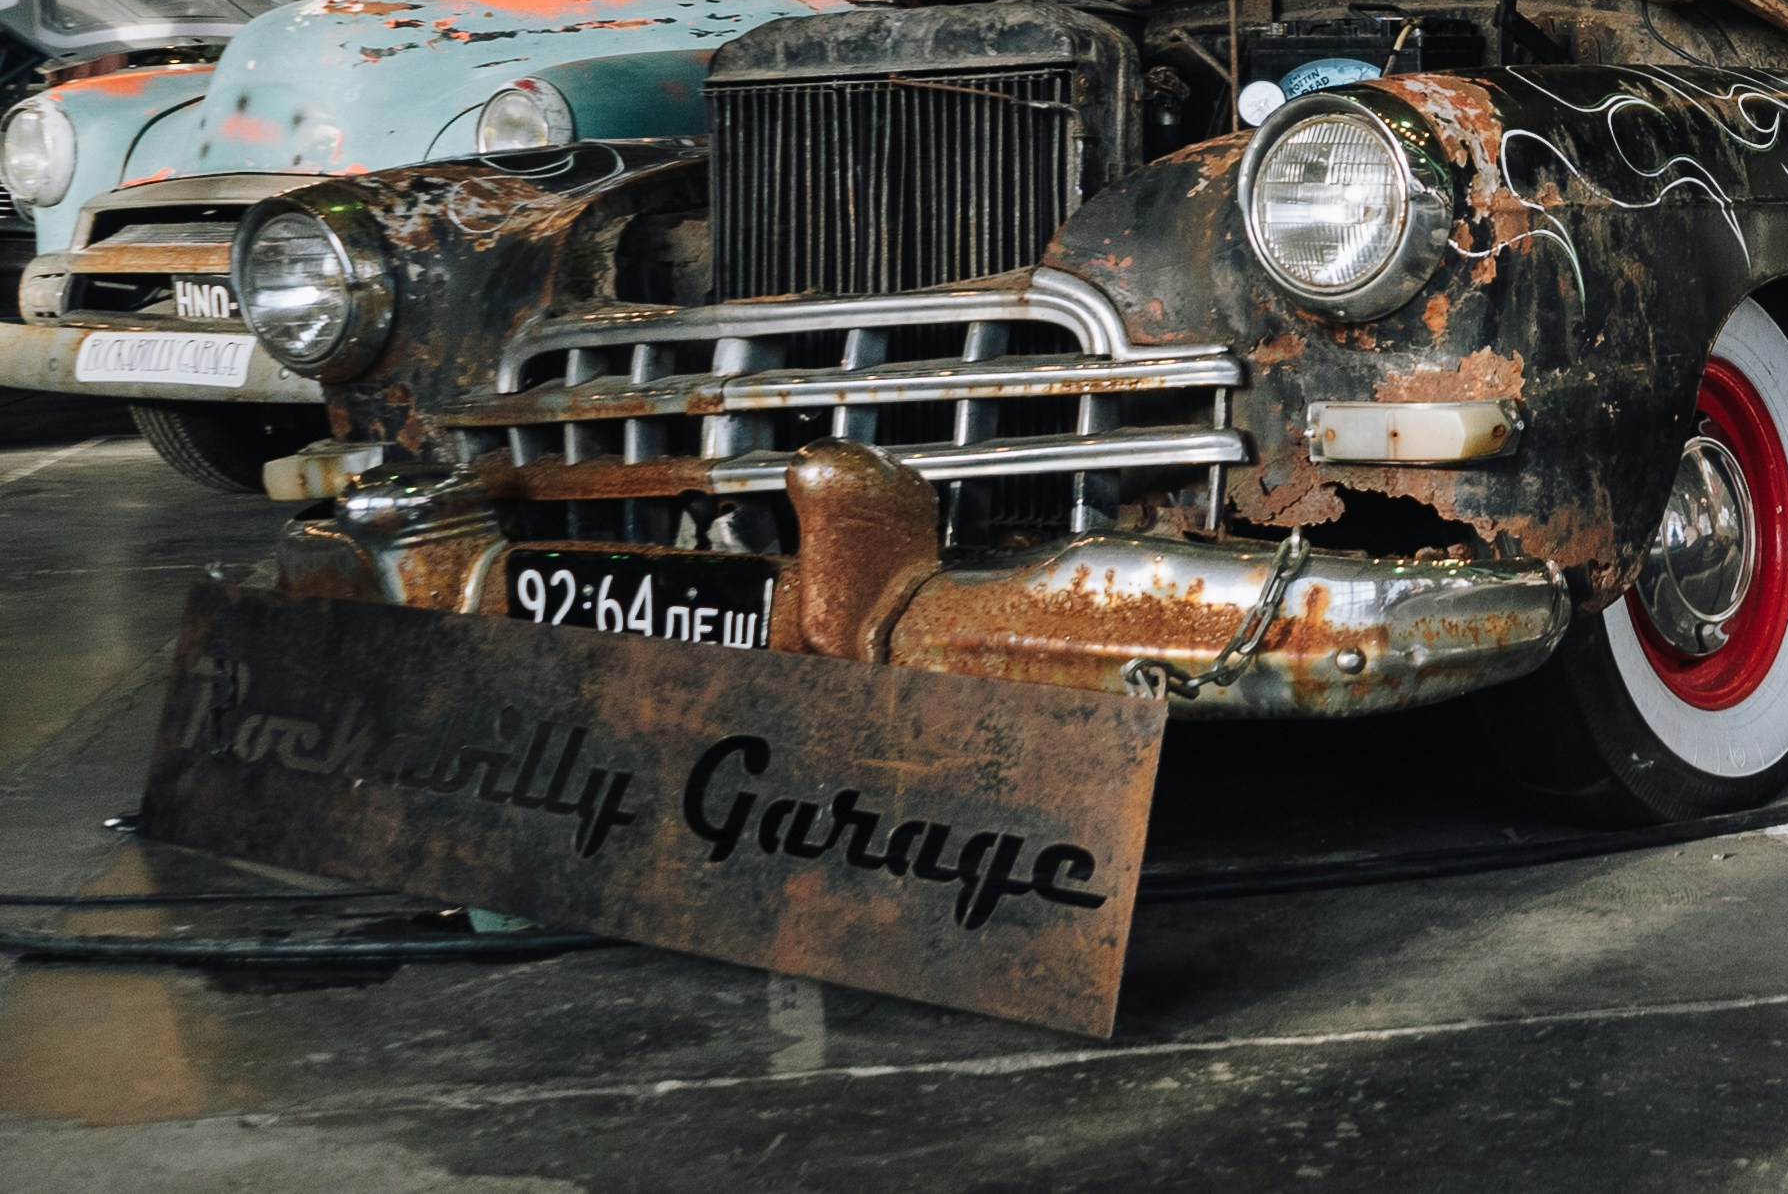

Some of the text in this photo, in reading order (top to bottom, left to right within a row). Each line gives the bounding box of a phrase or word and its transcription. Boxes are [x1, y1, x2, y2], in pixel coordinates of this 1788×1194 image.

[1290, 69, 1320, 95] ROTTEN
[182, 655, 1108, 931] Rockabilly Garage
